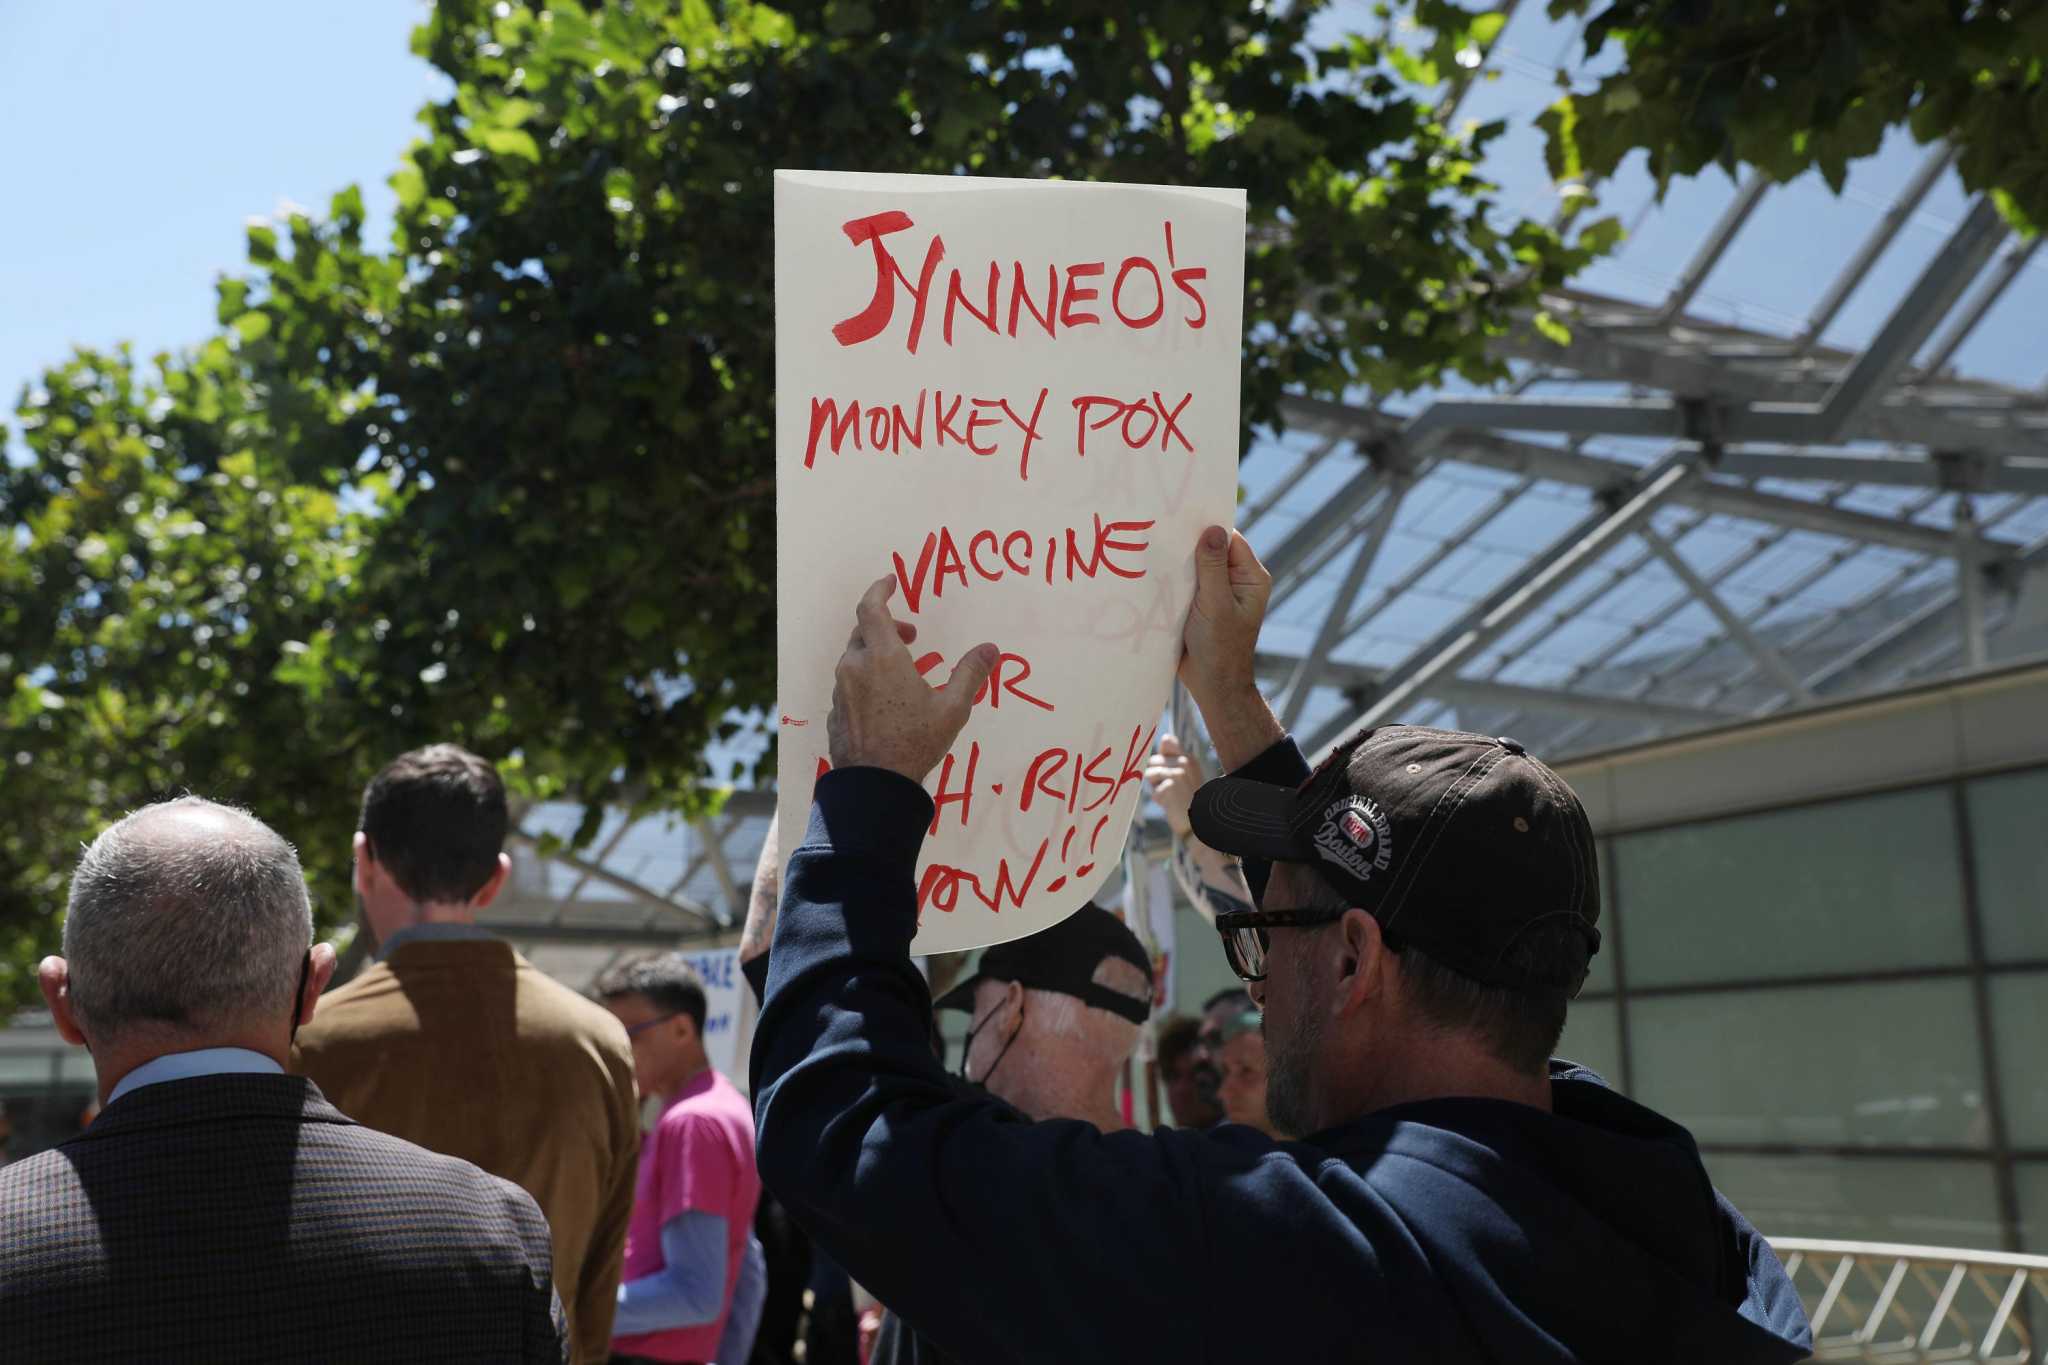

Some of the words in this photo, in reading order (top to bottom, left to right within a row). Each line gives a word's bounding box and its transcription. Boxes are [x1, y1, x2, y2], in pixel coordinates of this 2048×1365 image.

[832, 210, 1207, 354] JYNNEO'S
[804, 388, 1049, 481] MONKEY
[1071, 391, 1194, 456] POX
[892, 512, 1156, 614] VACCINE
[1373, 812, 1392, 870] BRAND
